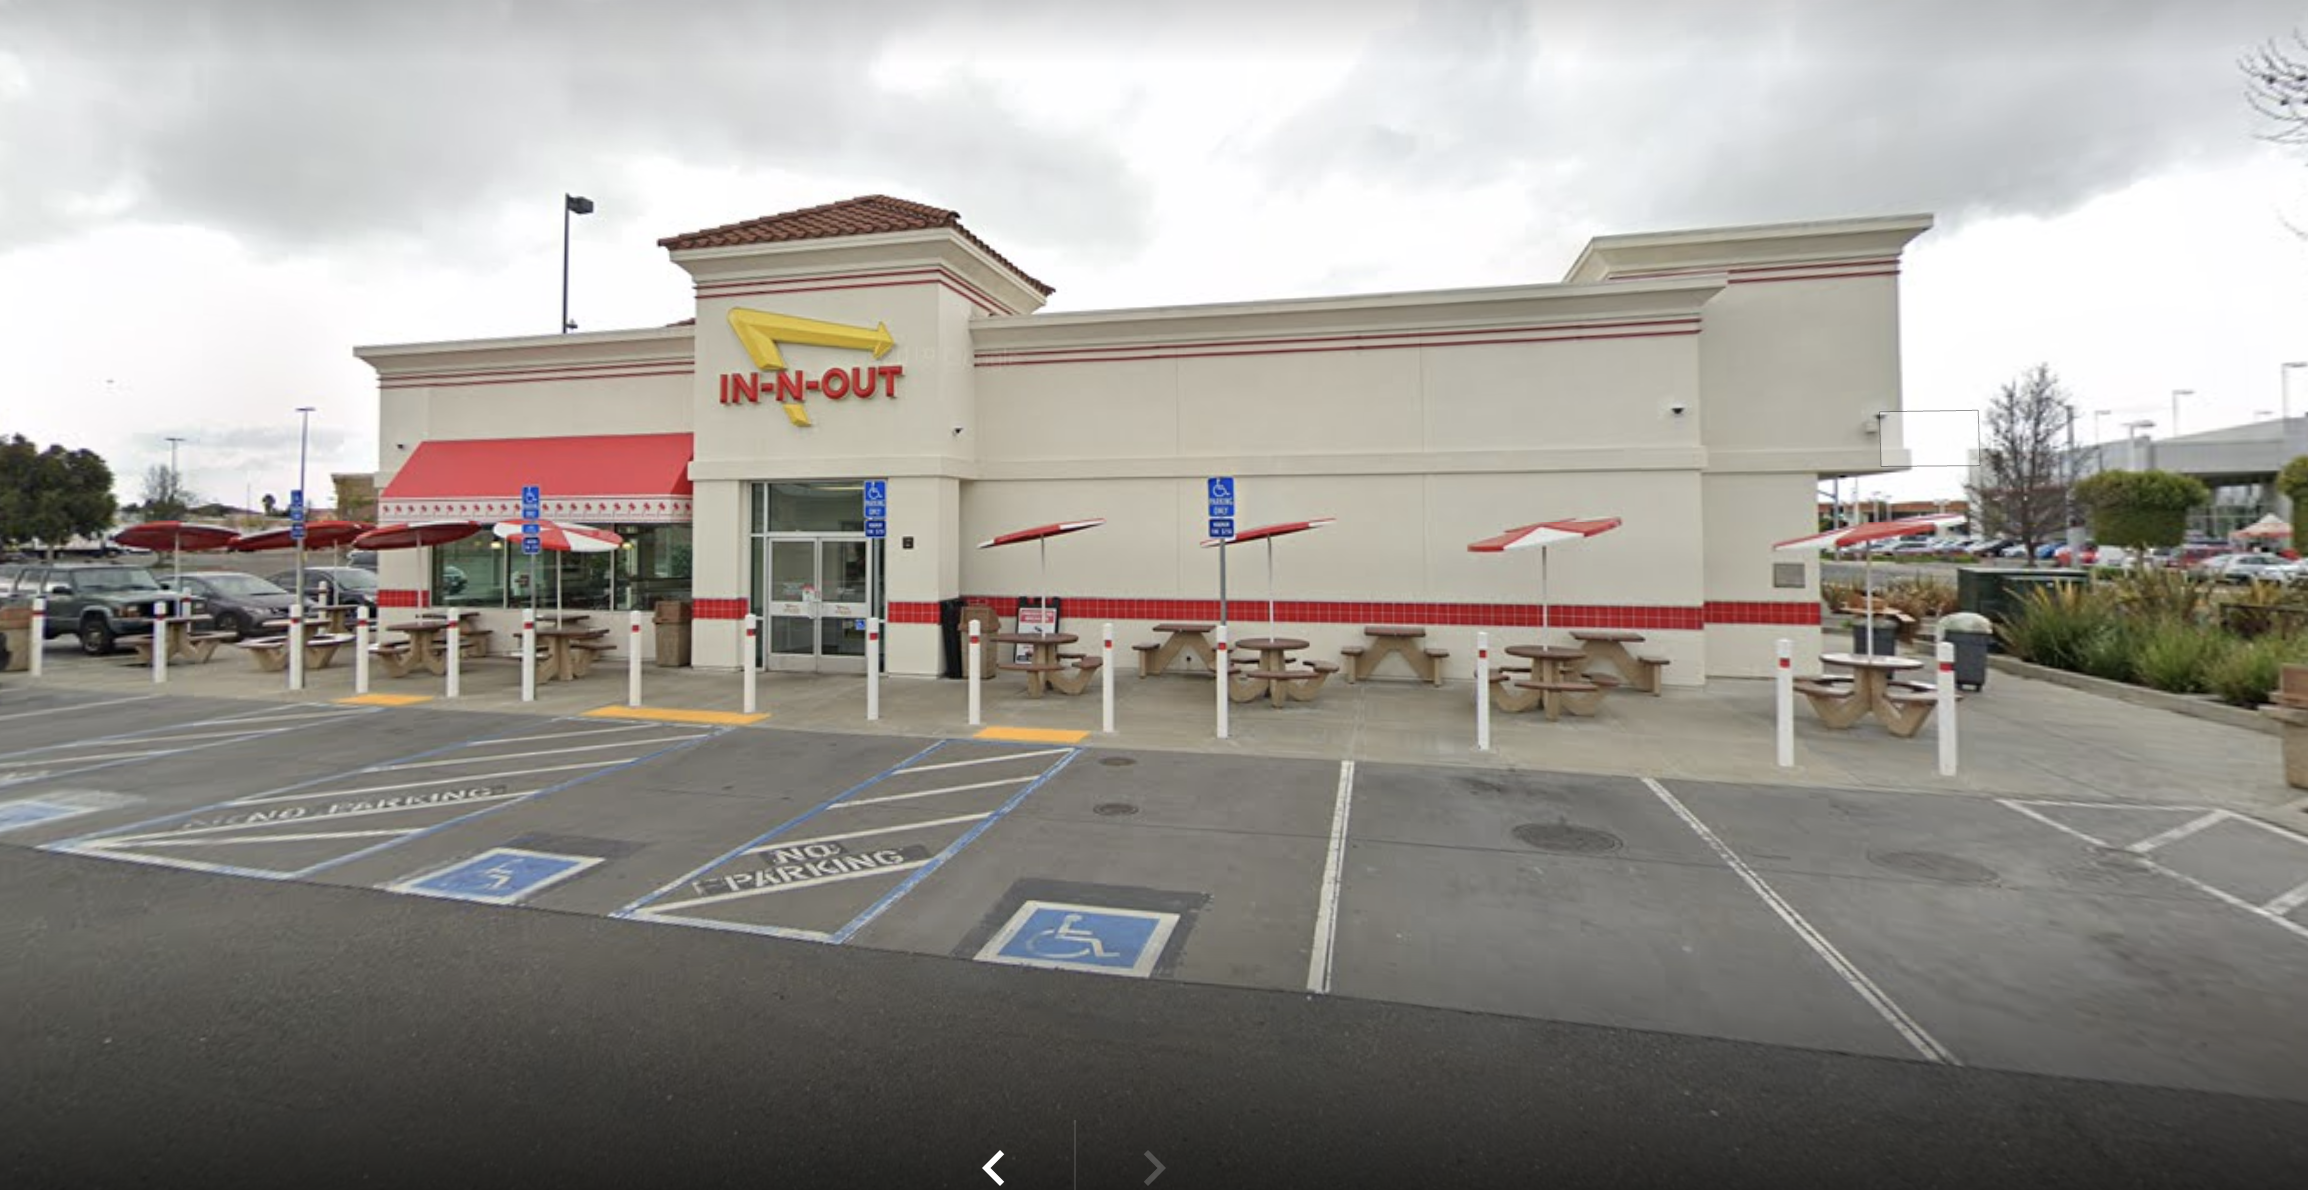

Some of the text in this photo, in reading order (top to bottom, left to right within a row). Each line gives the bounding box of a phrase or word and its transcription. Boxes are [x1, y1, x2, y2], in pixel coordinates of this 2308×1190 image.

[720, 366, 904, 404] IN-N-OUT
[246, 806, 305, 823] NO
[329, 786, 495, 815] PARKING
[724, 849, 904, 892] PARKING
[771, 843, 841, 865] NO
